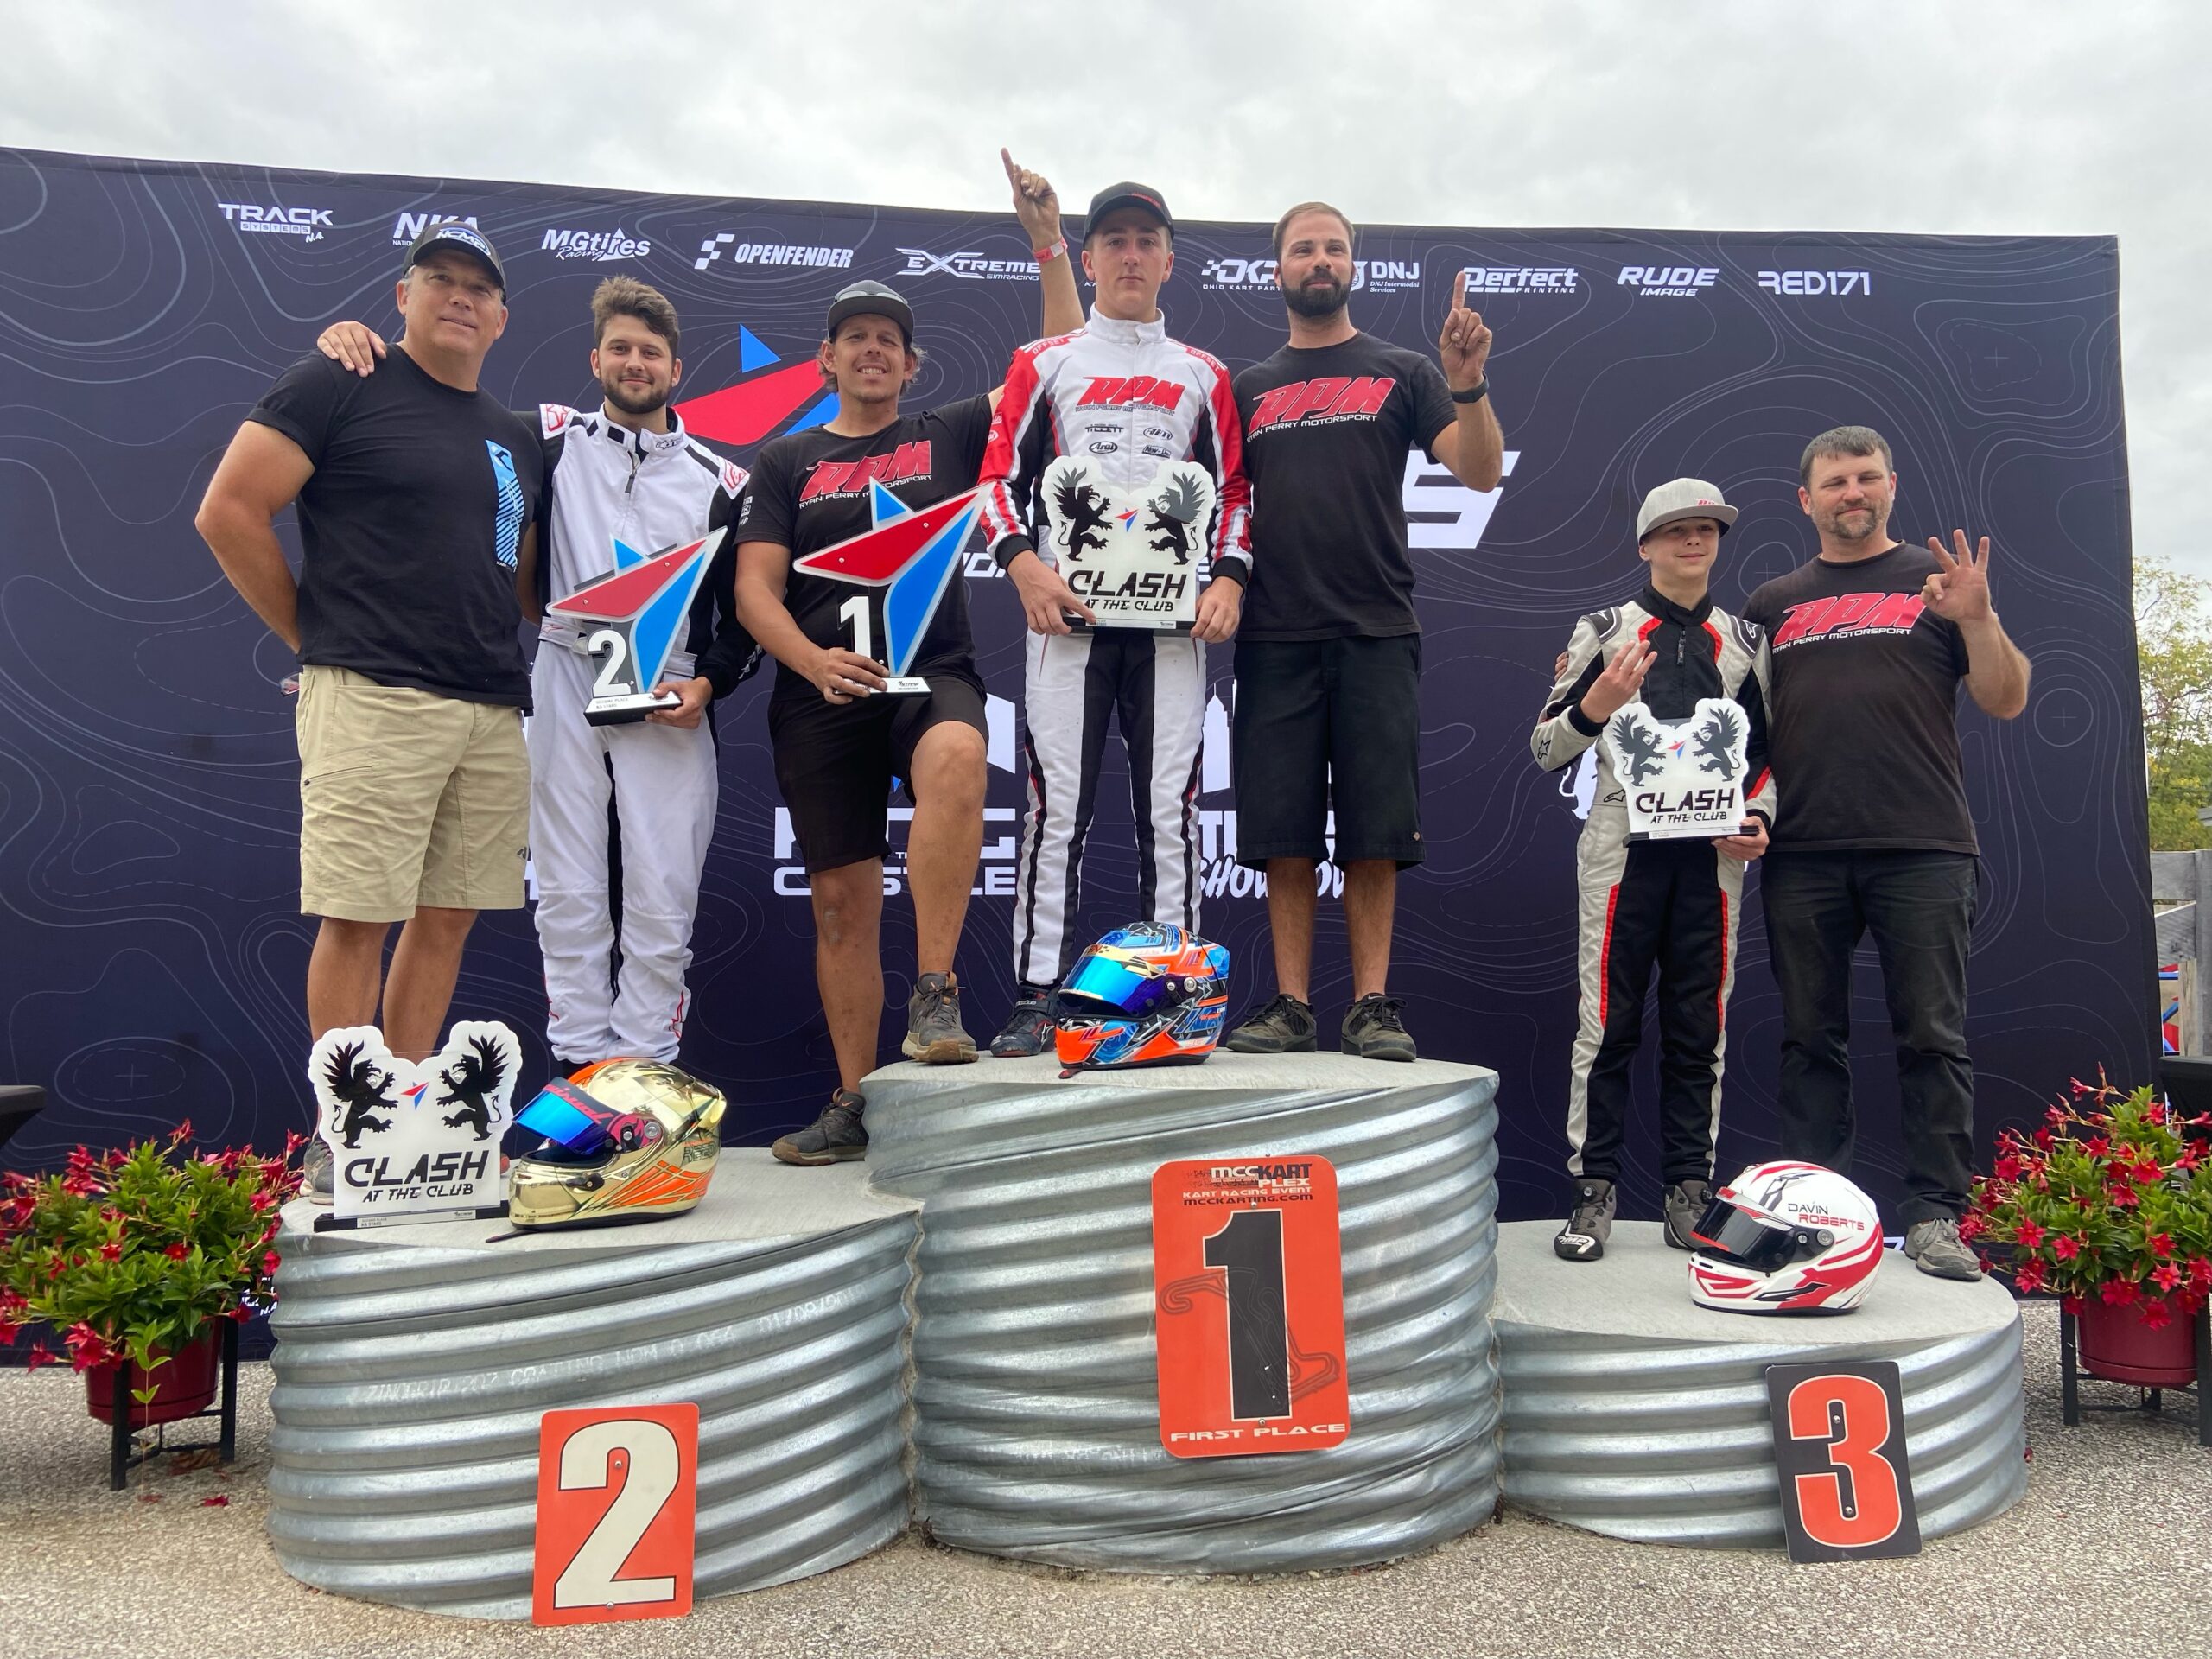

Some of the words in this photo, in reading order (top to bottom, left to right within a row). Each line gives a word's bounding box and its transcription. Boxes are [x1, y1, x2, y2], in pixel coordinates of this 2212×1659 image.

[218, 203, 333, 226] TRACK
[241, 222, 310, 234] SYSTEMS
[305, 232, 324, 243] N.A.
[555, 246, 605, 261] Racing
[734, 243, 854, 268] OPENFENDER
[895, 247, 1041, 279] EXTREME
[1370, 261, 1420, 280] DNJ
[1464, 267, 1578, 293] Perfect
[1617, 267, 1719, 286] RUDE
[1640, 288, 1698, 296] IMAGE
[1758, 270, 1871, 296] RED171
[1032, 338, 1066, 355] OFFSET
[1190, 348, 1220, 372] OFFSET
[1077, 375, 1185, 410] RPM
[1249, 377, 1396, 435] RPM
[1265, 422, 1298, 433] PERRY
[1300, 415, 1377, 427] MOTORSPORT
[799, 440, 931, 502] RPM
[799, 496, 823, 509] RYAN
[1068, 569, 1187, 599] CLASH
[1103, 600, 1131, 610] THE
[1135, 601, 1173, 612] CLUB
[1773, 593, 1926, 647] RPM
[1793, 635, 1827, 646] PERRY
[1828, 628, 1912, 639] MOTORSPORT
[588, 629, 632, 698] 2
[1636, 788, 1735, 813] CLASH
[1650, 815, 1663, 824] AT
[1668, 814, 1690, 823] THE
[1694, 811, 1727, 822] CLUB
[345, 1150, 490, 1187] CLASH
[363, 1190, 383, 1203] AT
[389, 1186, 421, 1200] THE
[426, 1183, 474, 1198] CLUB
[1221, 1188, 1268, 1197] RACING
[1259, 1178, 1310, 1188] PLEX
[1788, 1204, 1829, 1215] DAVIN
[1798, 1214, 1865, 1231] ROBERTS
[1203, 1208, 1293, 1421] 1
[1170, 1429, 1244, 1442] FIRST
[1254, 1423, 1346, 1438] PLACE
[1787, 1374, 1902, 1548] 3
[553, 1418, 681, 1611] 2
